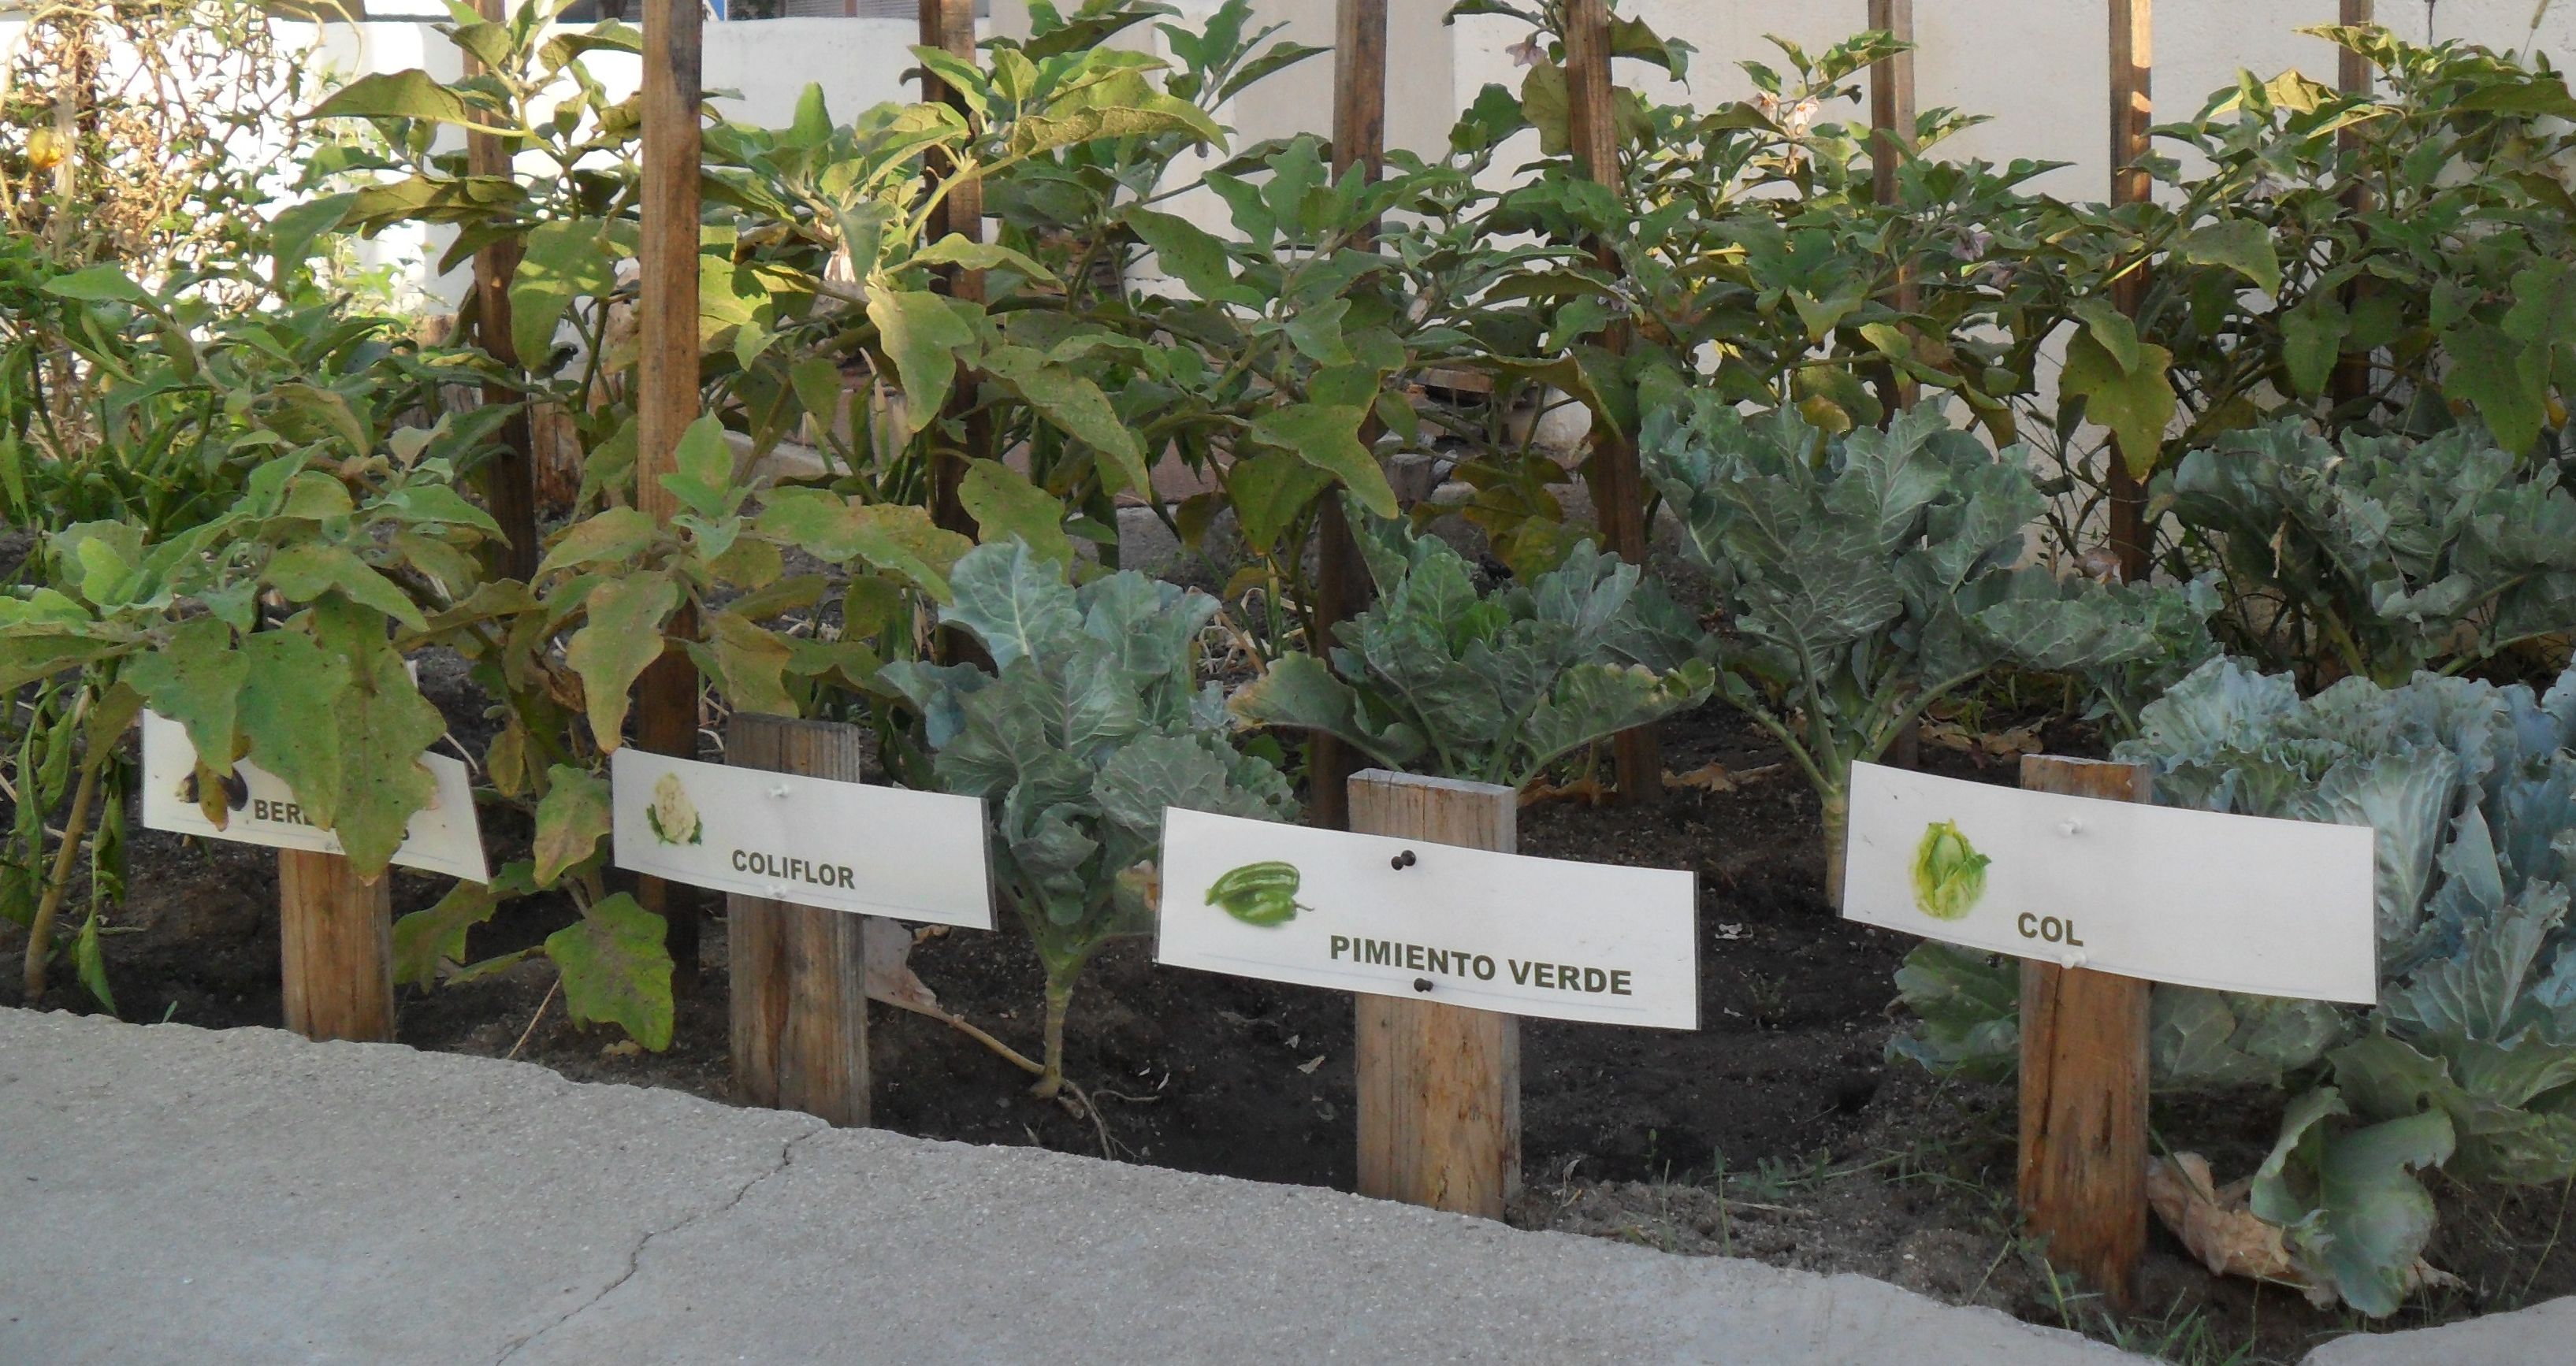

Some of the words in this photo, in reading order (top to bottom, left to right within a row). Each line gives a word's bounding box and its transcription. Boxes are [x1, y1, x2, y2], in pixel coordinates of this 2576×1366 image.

[732, 849, 855, 889] COLIFLOR
[2017, 912, 2083, 947] COL
[1330, 935, 1496, 981] PIMIENTO
[1508, 959, 1632, 996] VERDE
